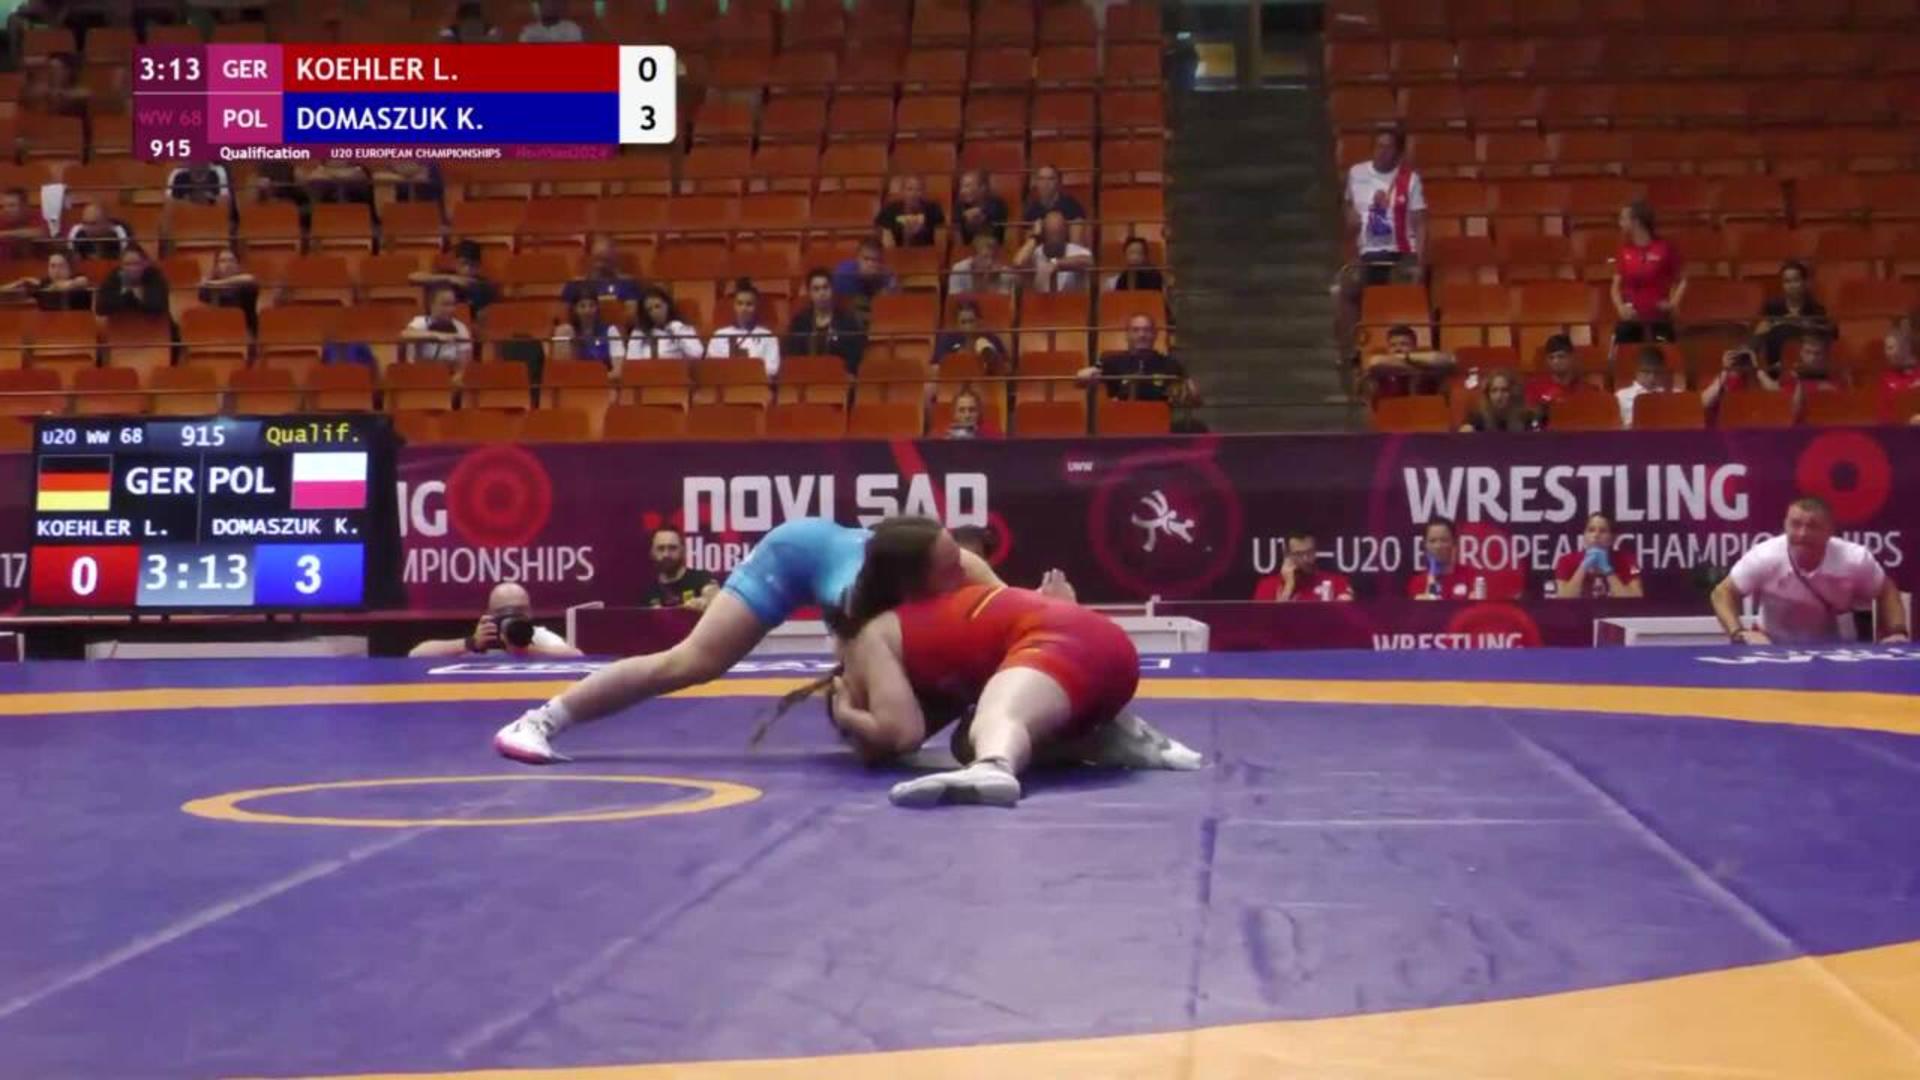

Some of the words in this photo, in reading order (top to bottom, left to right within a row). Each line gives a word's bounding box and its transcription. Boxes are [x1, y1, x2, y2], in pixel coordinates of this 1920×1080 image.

[119, 427, 143, 444] 68
[180, 425, 226, 446] 915
[266, 423, 360, 446] Qualif.
[125, 466, 195, 495] GER
[208, 465, 276, 494] POL
[1404, 463, 1749, 524] WRESTLING
[855, 472, 988, 530] SAD
[37, 519, 131, 537] KOEHLER
[144, 519, 168, 536] L.
[212, 517, 322, 535] DOMASZUK
[334, 517, 359, 535] K.
[71, 555, 98, 595] 0
[145, 553, 248, 590] 3:13
[295, 554, 322, 594] 3
